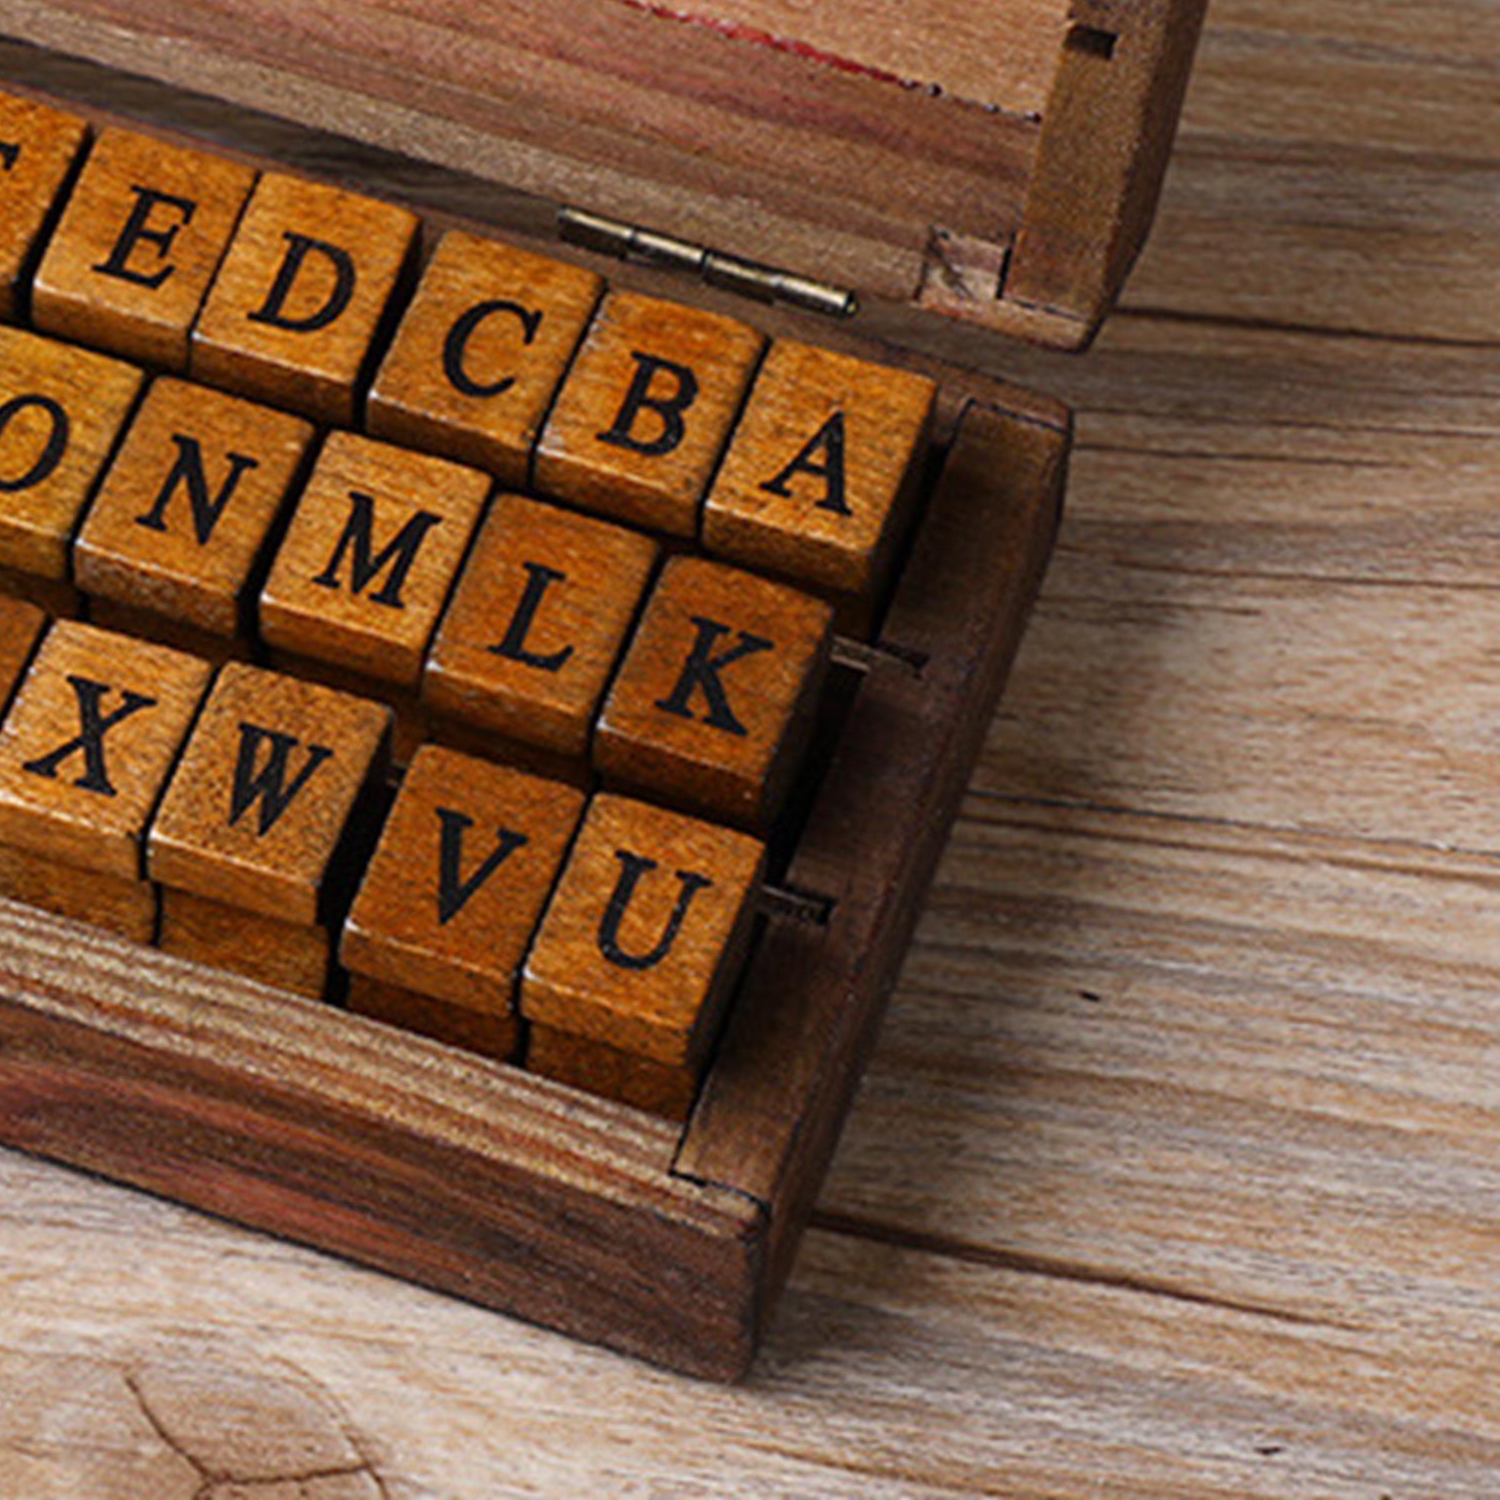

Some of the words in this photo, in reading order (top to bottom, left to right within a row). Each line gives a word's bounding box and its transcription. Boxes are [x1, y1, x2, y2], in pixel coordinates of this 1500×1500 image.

[93, 185, 197, 289] E
[247, 231, 356, 333] D
[442, 300, 543, 399] C
[596, 351, 700, 457] B
[760, 411, 853, 517] A
[135, 434, 259, 546] N
[312, 491, 442, 609] M
[487, 561, 574, 672] L
[655, 616, 774, 737] K
[22, 676, 157, 797] X
[227, 721, 334, 837] W
[435, 807, 529, 925] V
[597, 850, 713, 971] U
